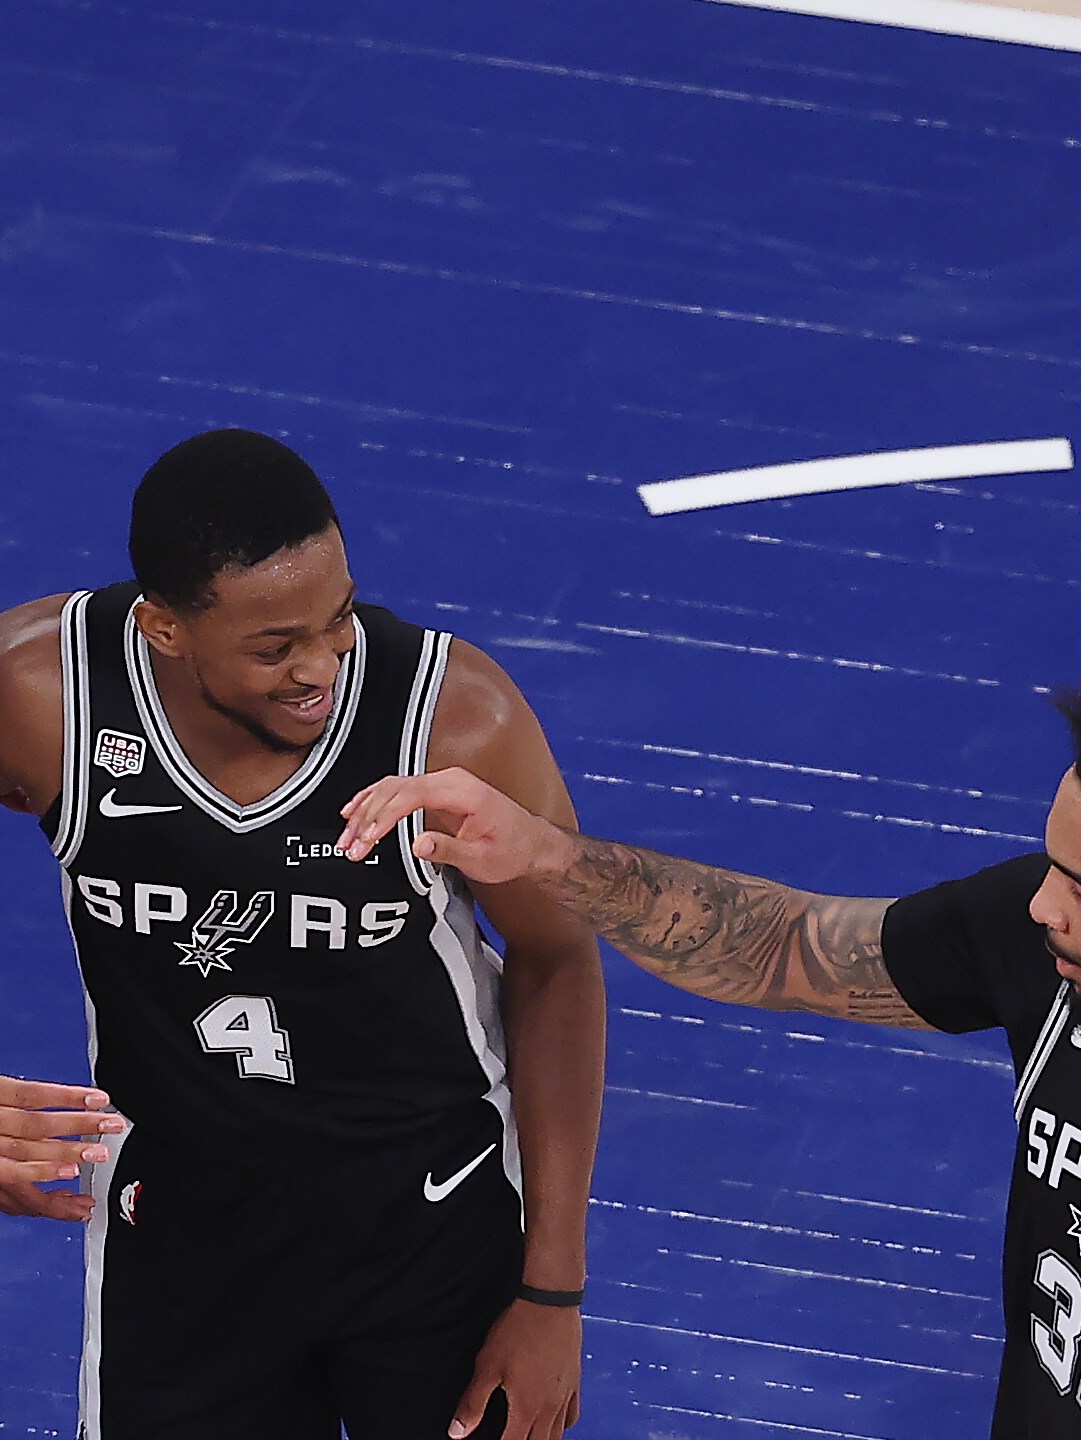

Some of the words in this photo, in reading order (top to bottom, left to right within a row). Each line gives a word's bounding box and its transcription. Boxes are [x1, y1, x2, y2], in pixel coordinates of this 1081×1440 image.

[103, 736, 139, 752] USA
[99, 751, 139, 770] 250
[298, 844, 354, 858] LEDG
[193, 995, 295, 1084] 4
[1031, 1249, 1081, 1402] 3
